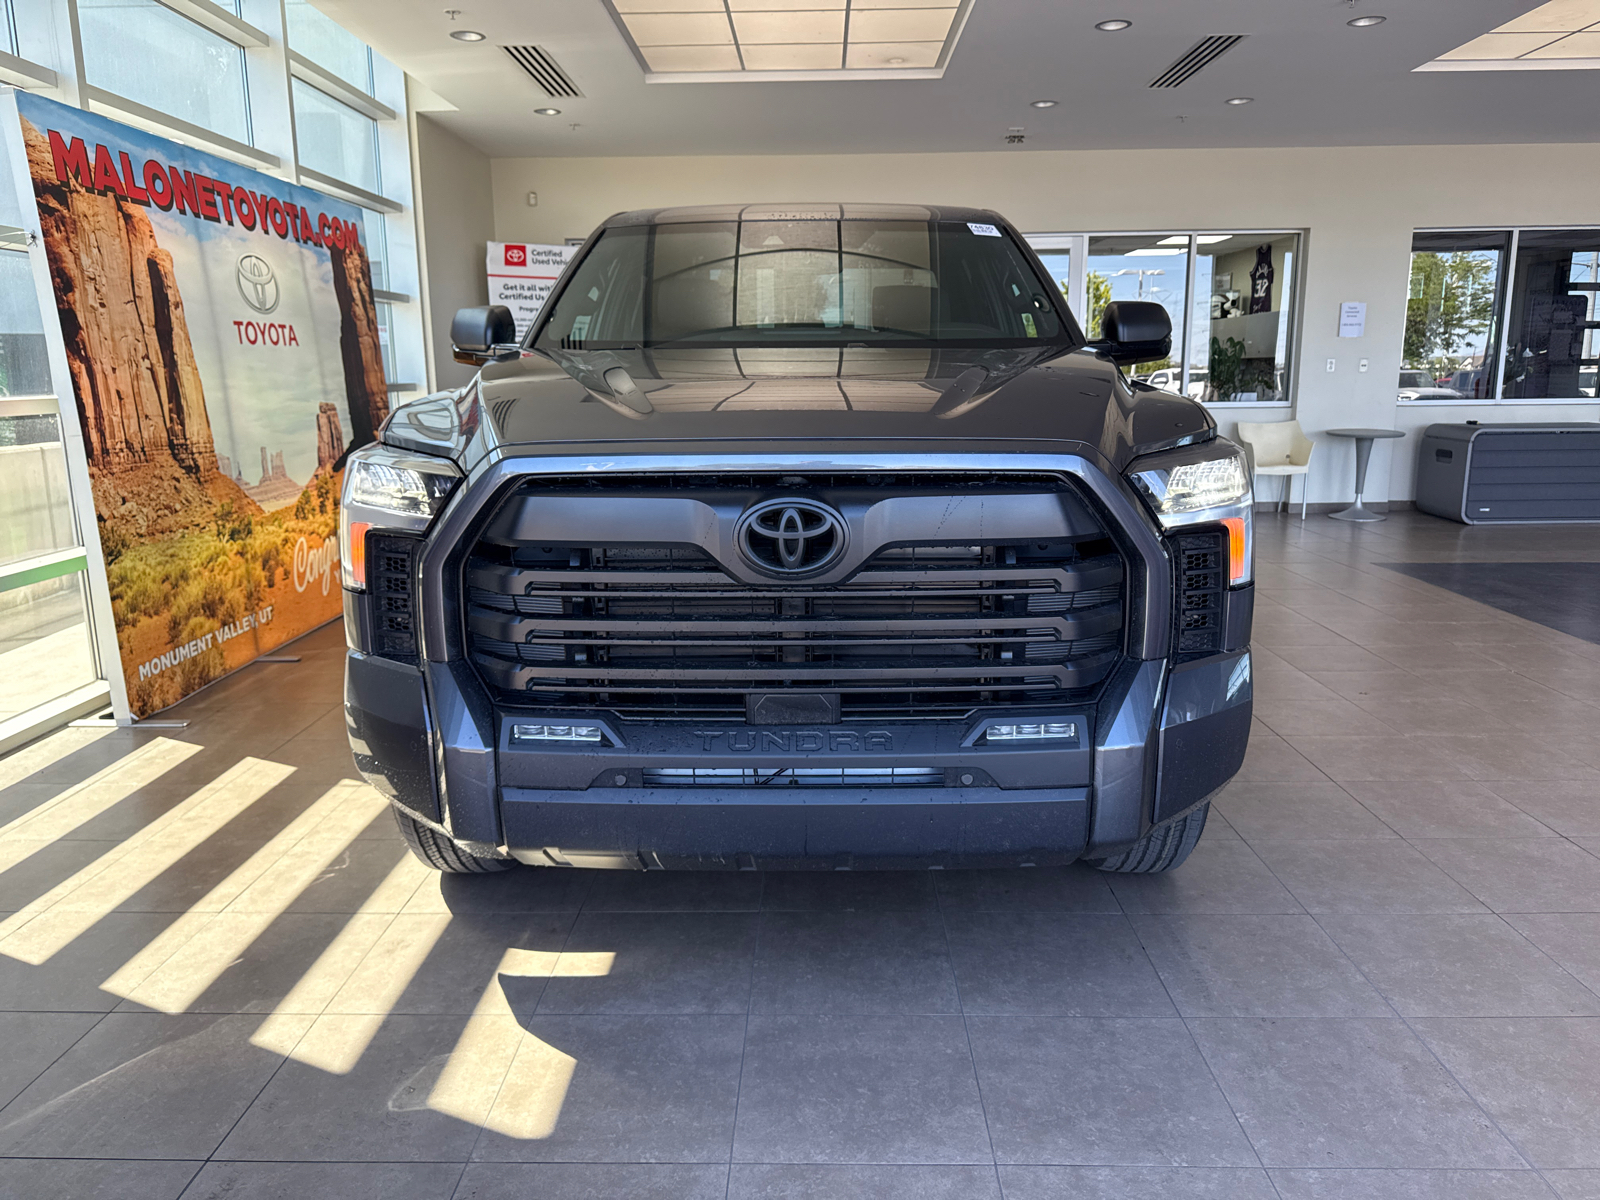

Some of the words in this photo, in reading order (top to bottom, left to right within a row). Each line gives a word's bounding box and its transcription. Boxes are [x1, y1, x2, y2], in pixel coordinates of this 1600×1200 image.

[47, 129, 361, 251] MALONETOYOTA.COM
[532, 249, 562, 258] Certified
[551, 258, 567, 266] Vehi
[503, 283, 518, 291] Get
[527, 284, 537, 292] all
[1254, 278, 1269, 298] 32
[233, 320, 299, 347] TOYOTA
[138, 632, 214, 682] MONUMENT
[215, 613, 258, 644] VALLEY,
[259, 606, 273, 626] UT
[693, 730, 894, 752] TUNDRA
